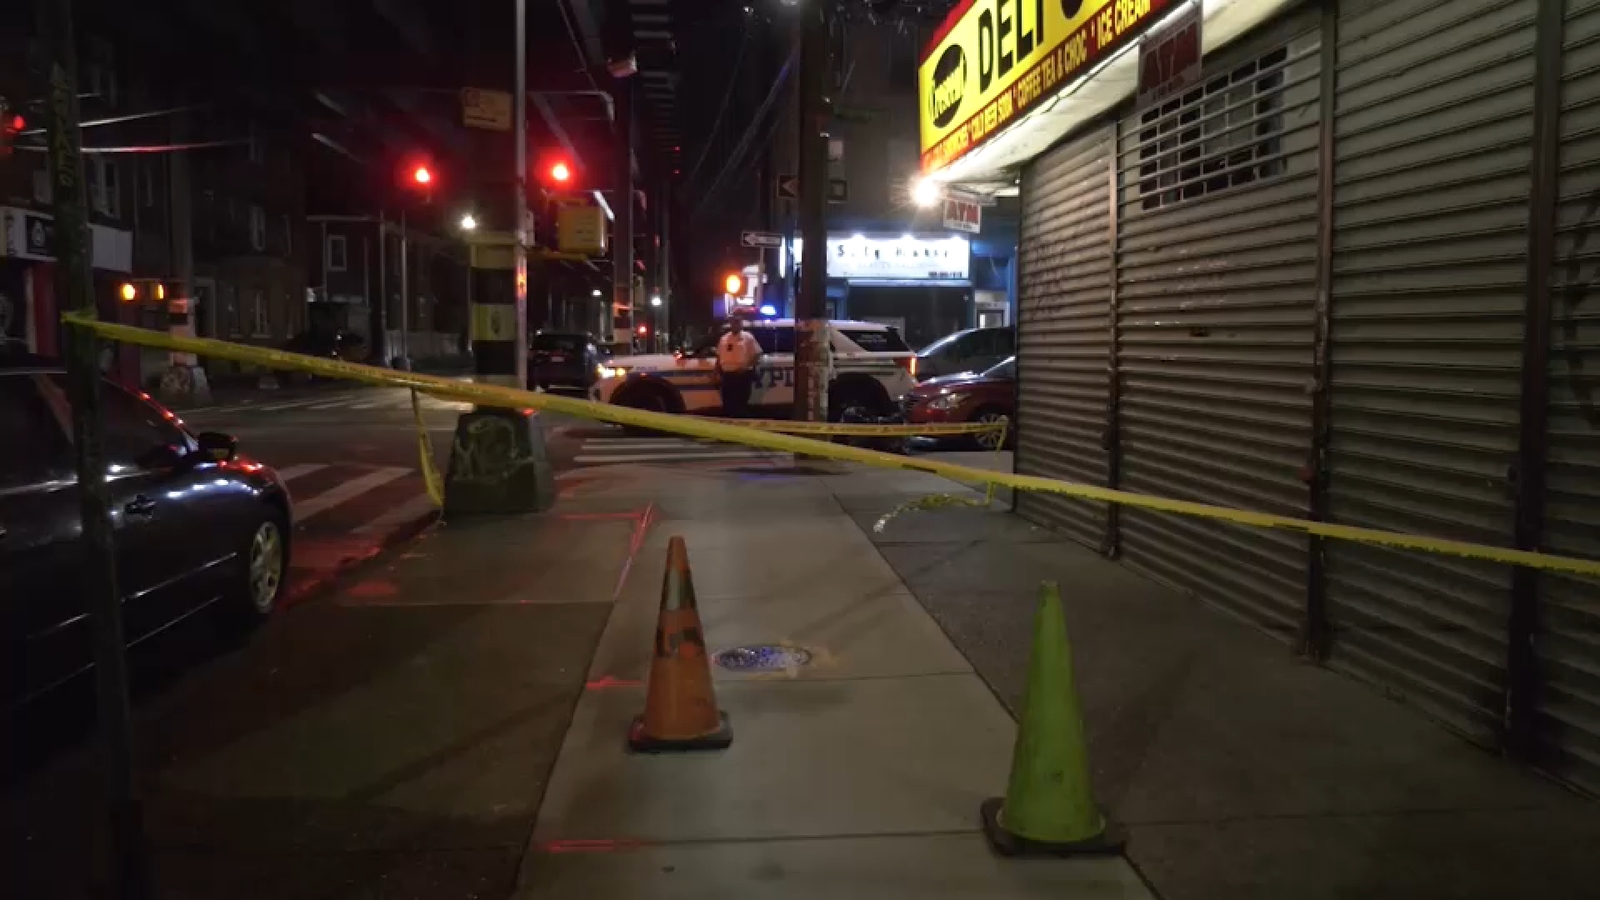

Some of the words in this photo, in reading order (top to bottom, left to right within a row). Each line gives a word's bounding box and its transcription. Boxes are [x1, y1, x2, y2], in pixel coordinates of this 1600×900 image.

[978, 0, 1043, 94] DELI
[1017, 66, 1041, 109] COFFEE
[1042, 53, 1056, 90] TEA
[1065, 28, 1087, 74] CHOC
[1098, 6, 1113, 49] ICE
[1140, 20, 1198, 95] ATM
[946, 200, 979, 225] ATM
